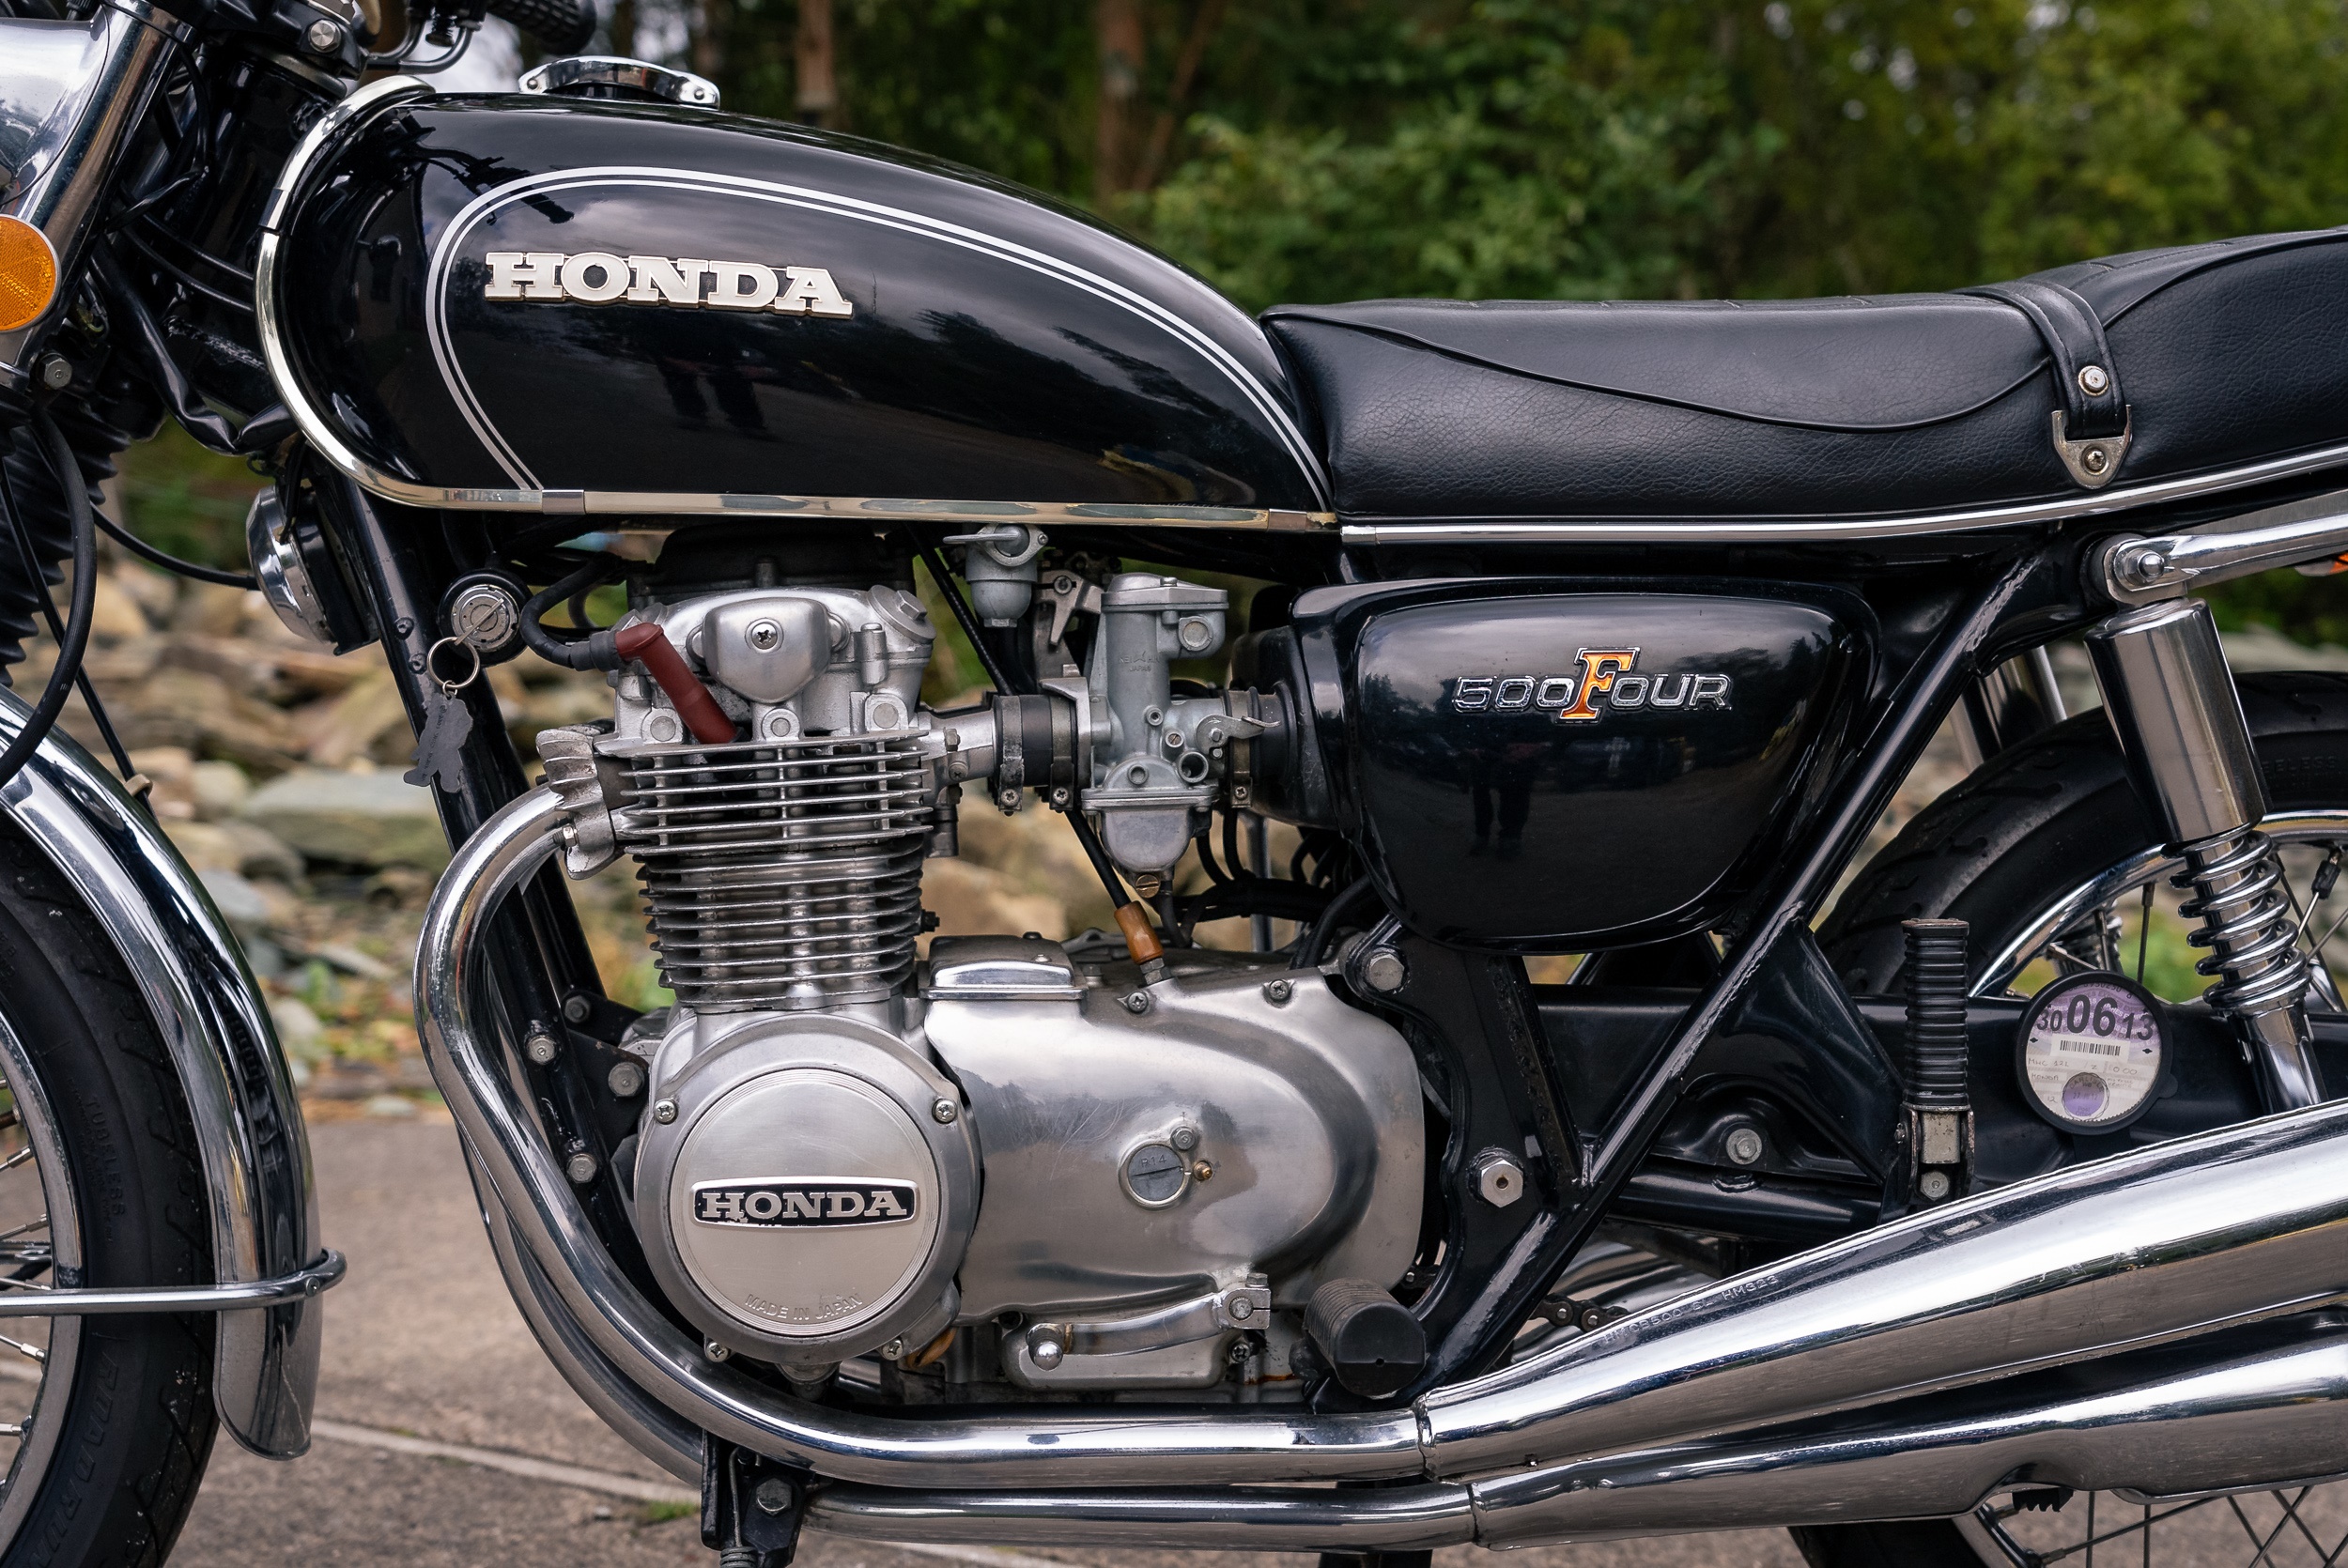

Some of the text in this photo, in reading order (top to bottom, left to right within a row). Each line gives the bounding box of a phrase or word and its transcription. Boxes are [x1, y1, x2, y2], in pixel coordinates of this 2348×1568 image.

[485, 252, 853, 318] HONDA
[2036, 994, 2154, 1040] 30 06 13
[85, 1093, 126, 1216] TUBELESS
[702, 1191, 907, 1219] HONDA
[744, 1293, 863, 1321] MADE IN JAPAN
